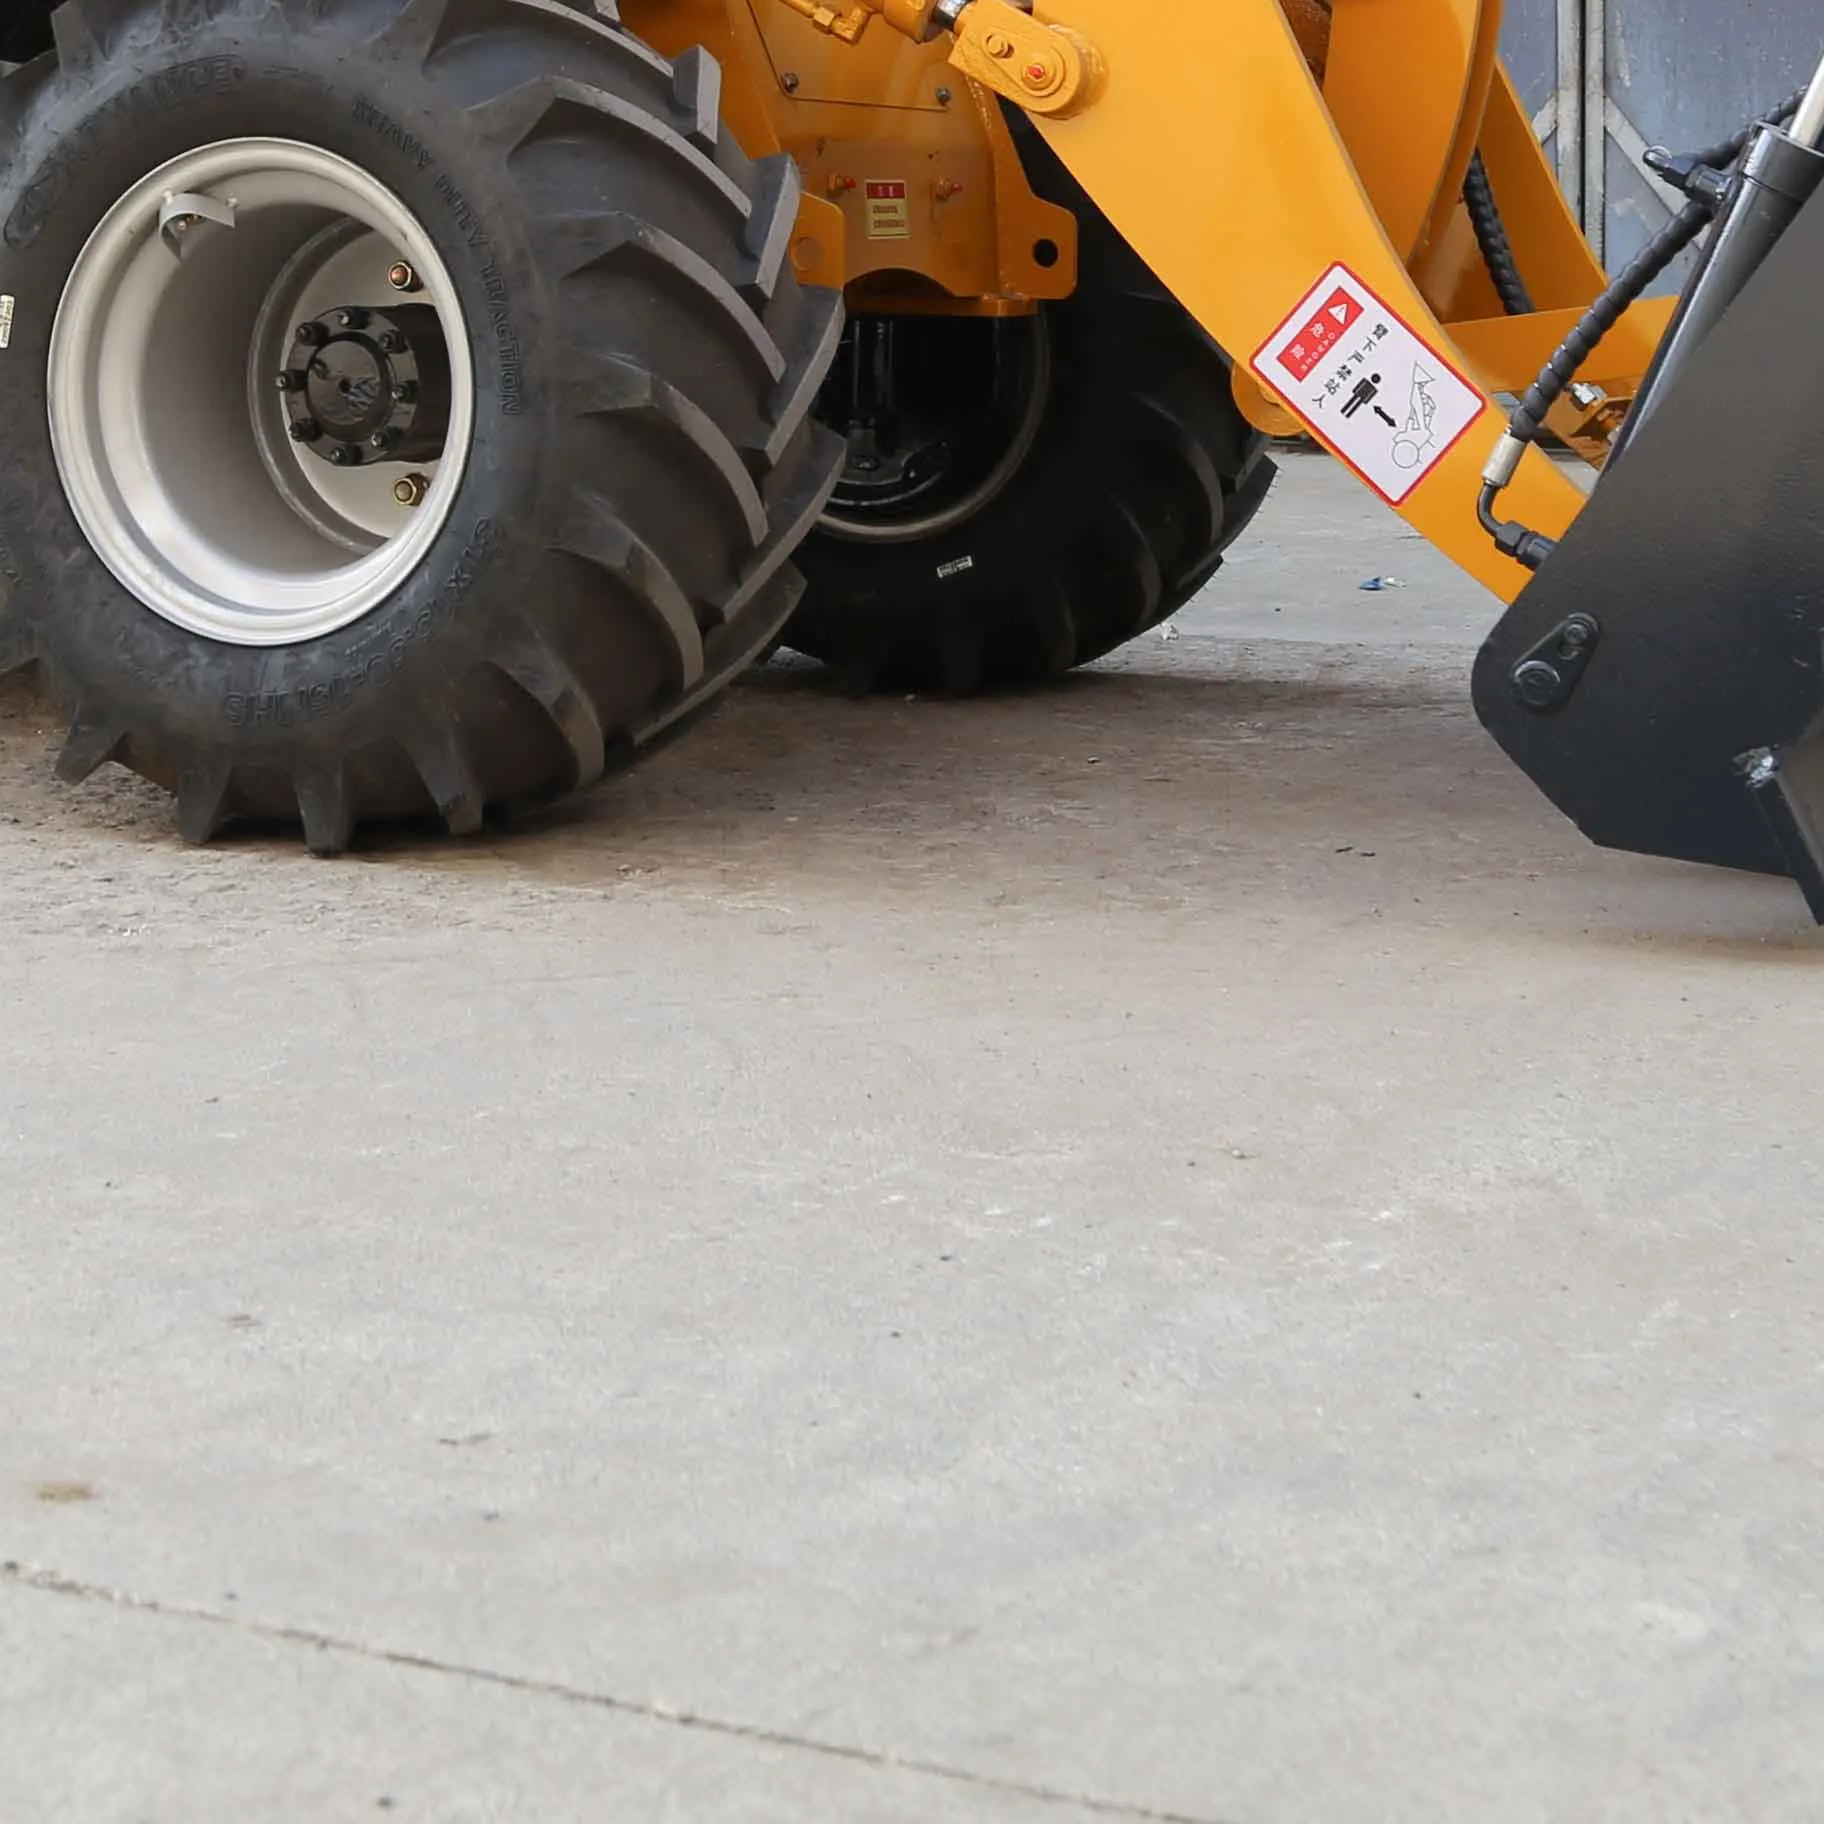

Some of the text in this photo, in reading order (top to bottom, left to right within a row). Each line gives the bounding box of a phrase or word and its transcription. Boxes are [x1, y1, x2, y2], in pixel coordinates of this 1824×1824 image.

[481, 257, 524, 416] TRACTION
[1300, 331, 1336, 372] DANGER
[1312, 323, 1390, 409] 臂下严禁站人
